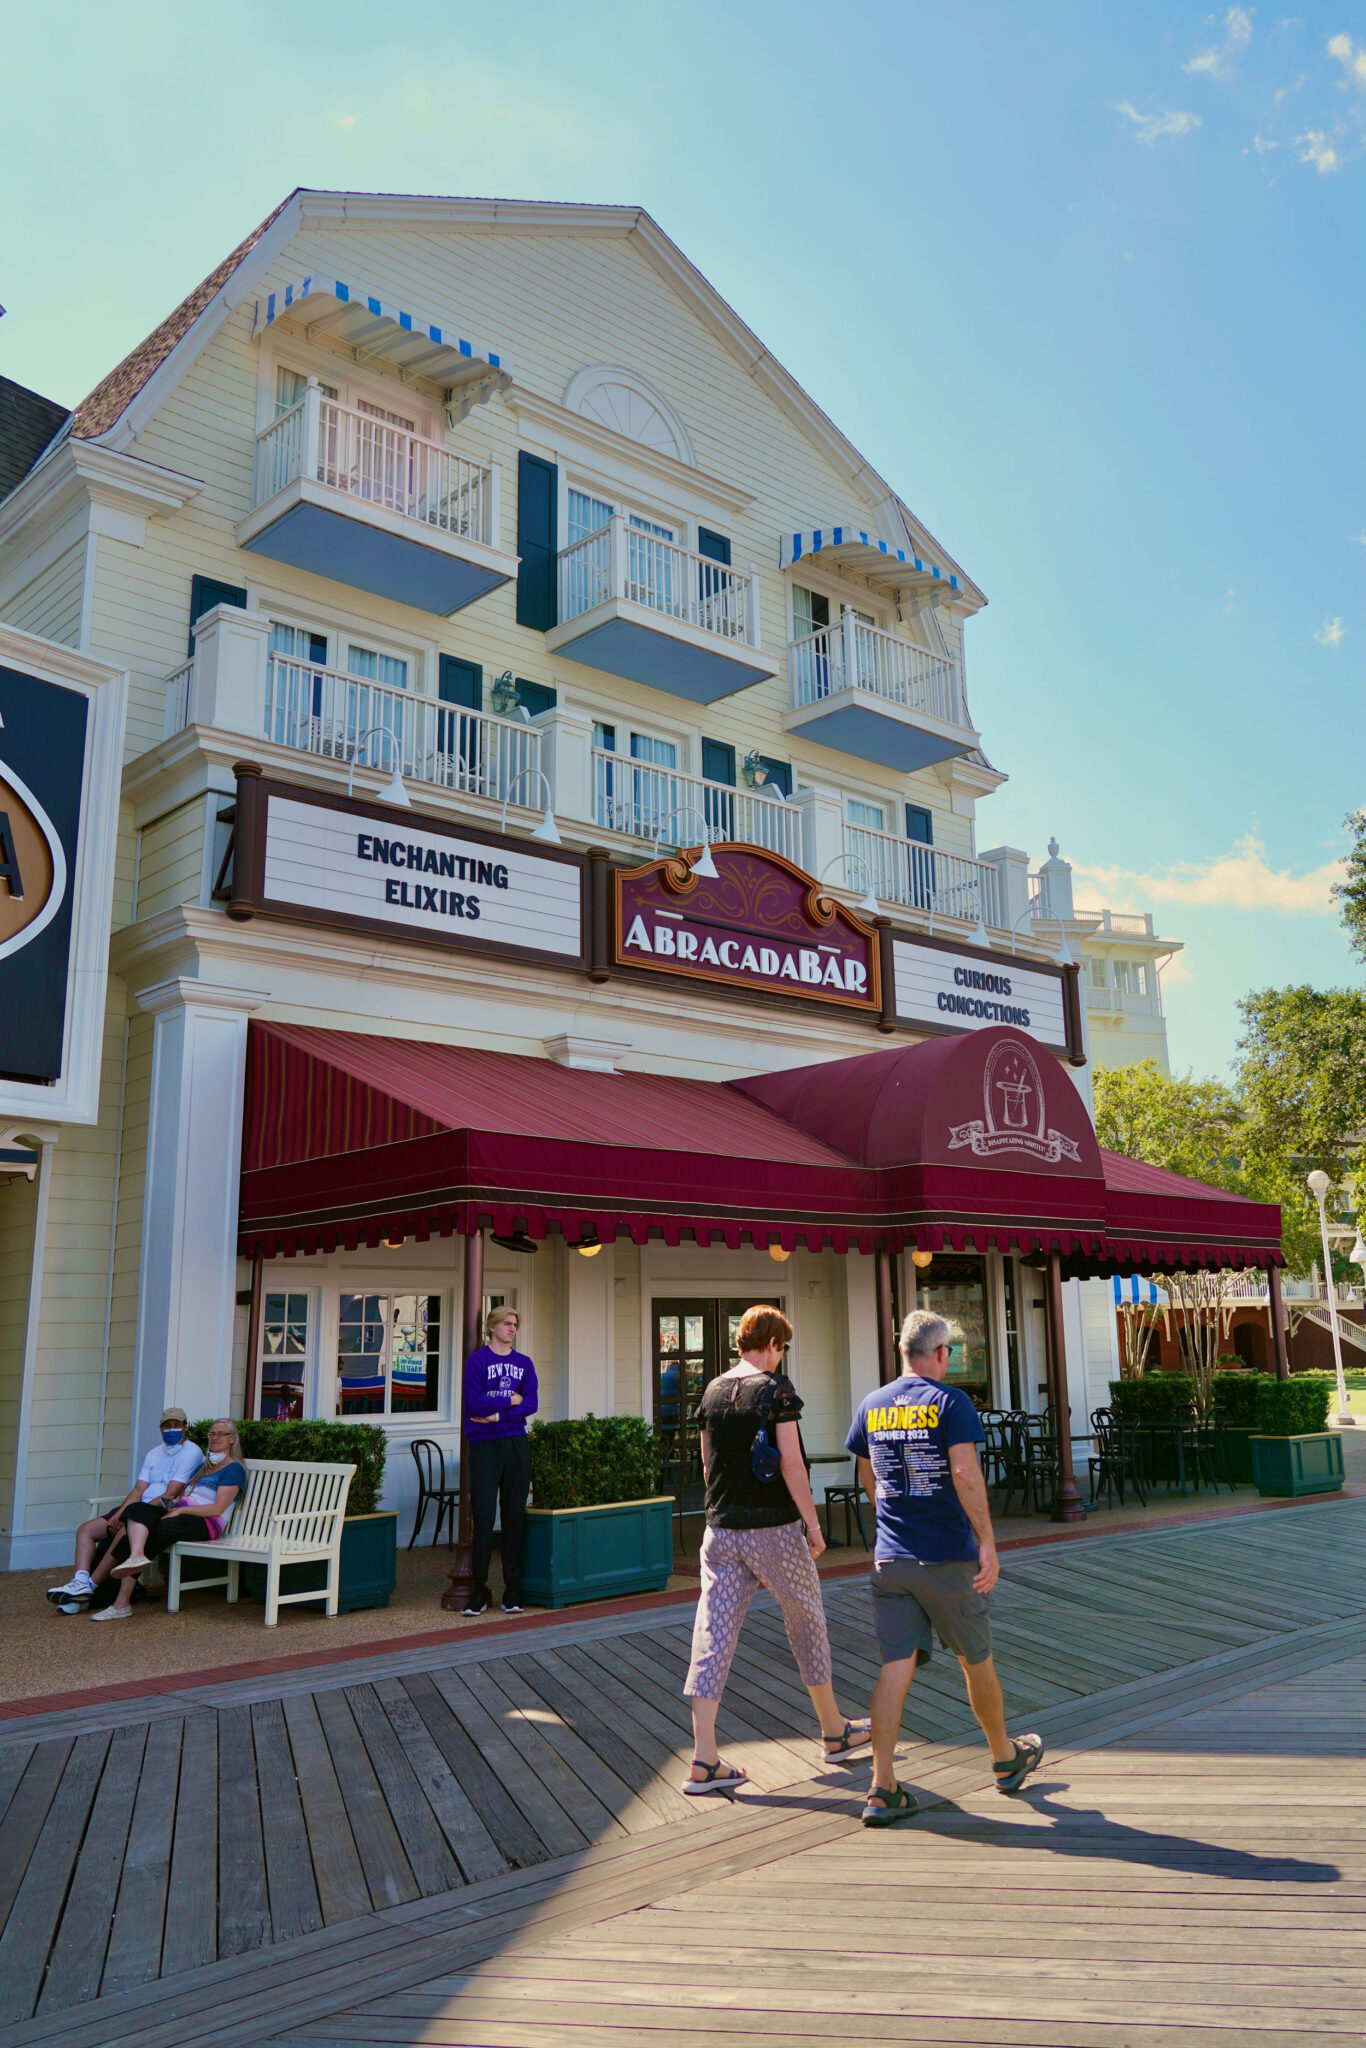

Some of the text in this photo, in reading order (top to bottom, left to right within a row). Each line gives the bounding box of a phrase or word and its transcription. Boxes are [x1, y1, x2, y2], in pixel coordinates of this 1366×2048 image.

[357, 833, 509, 890] ENCHANTING
[385, 878, 481, 920] ELIXIRS
[623, 914, 868, 994] ABRACADABAR
[954, 966, 1012, 997] CURIOUS
[937, 991, 1031, 1027] CONCOCTIONS
[487, 1362, 524, 1380] NEW YORK
[867, 1404, 939, 1433] MADNESS
[873, 1429, 930, 1442] SUMMER 2022
